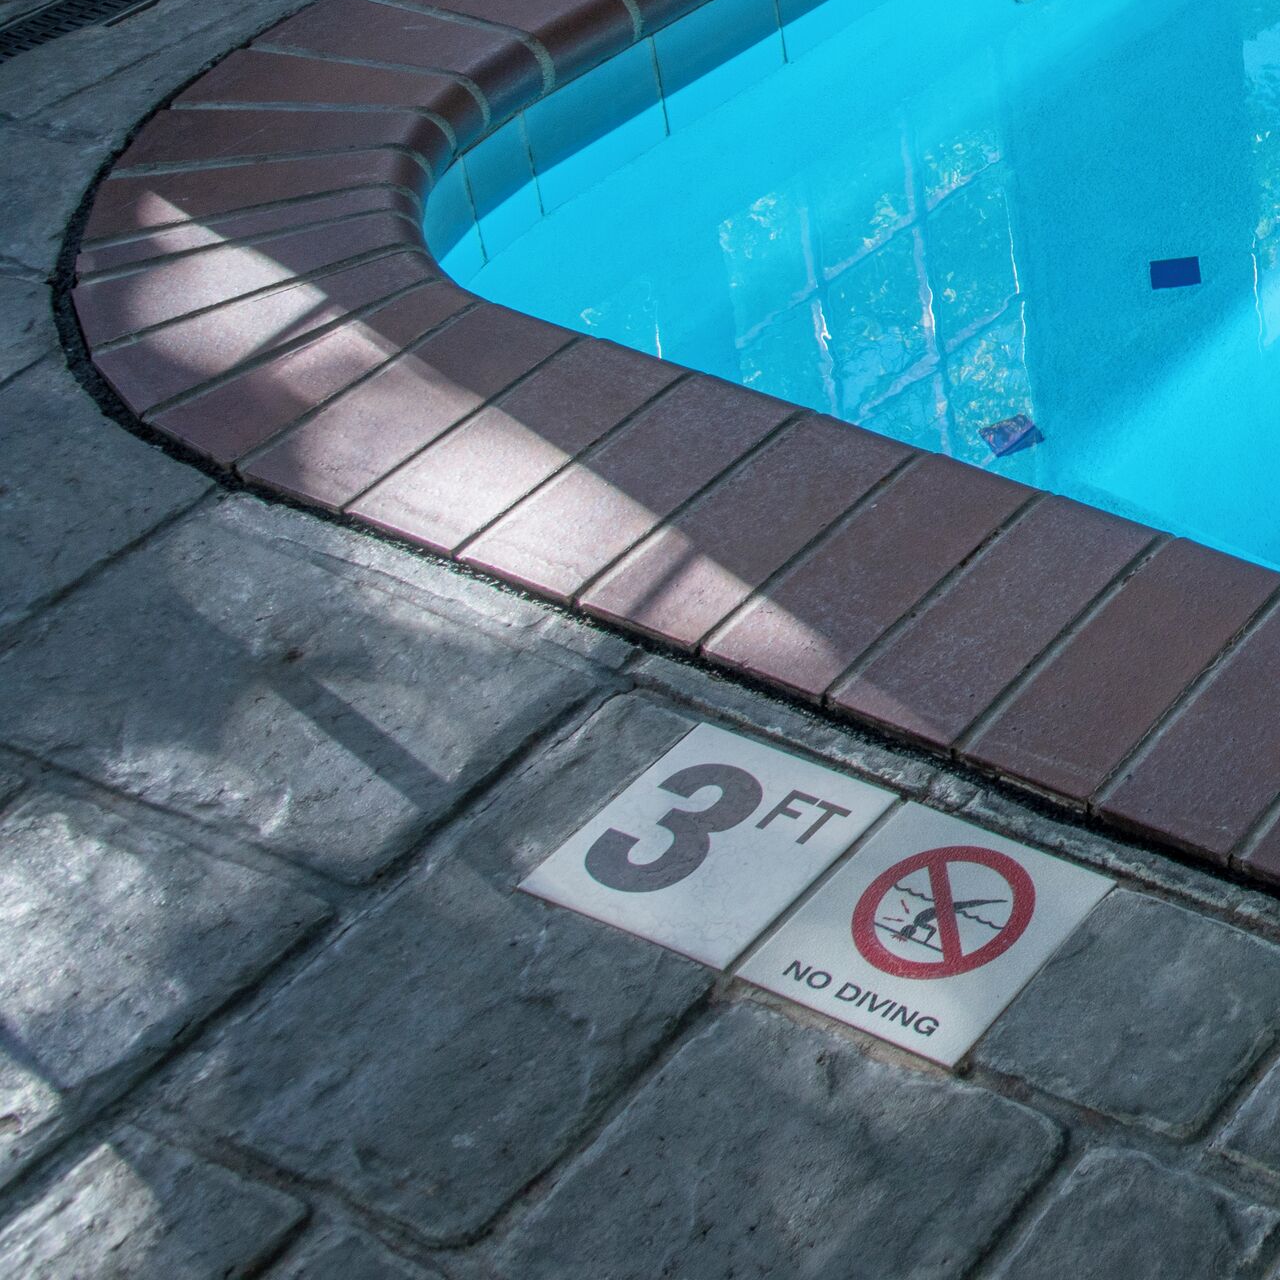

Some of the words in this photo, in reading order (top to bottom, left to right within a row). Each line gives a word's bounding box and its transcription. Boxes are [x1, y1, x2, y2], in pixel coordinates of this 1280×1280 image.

[584, 762, 764, 893] 3
[754, 789, 853, 846] FT
[782, 959, 833, 990] NO
[834, 981, 940, 1037] DIVING
